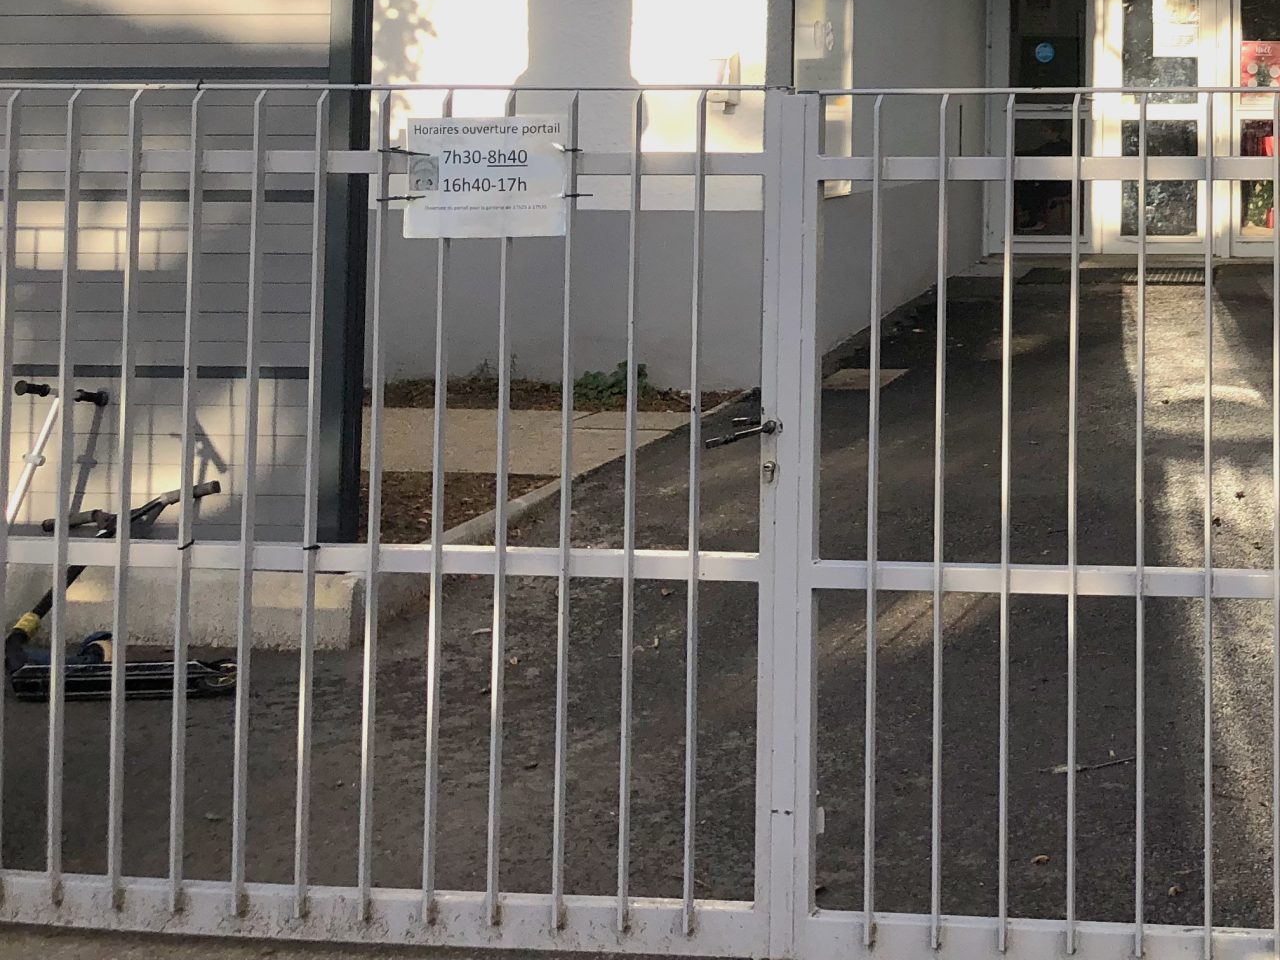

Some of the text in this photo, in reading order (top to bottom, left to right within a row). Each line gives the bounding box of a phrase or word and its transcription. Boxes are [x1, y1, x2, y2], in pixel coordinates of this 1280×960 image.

[414, 123, 561, 136] Horaires ouverture portail
[443, 150, 528, 164] 7h30-8h40
[443, 178, 527, 192] 16h40-17h
